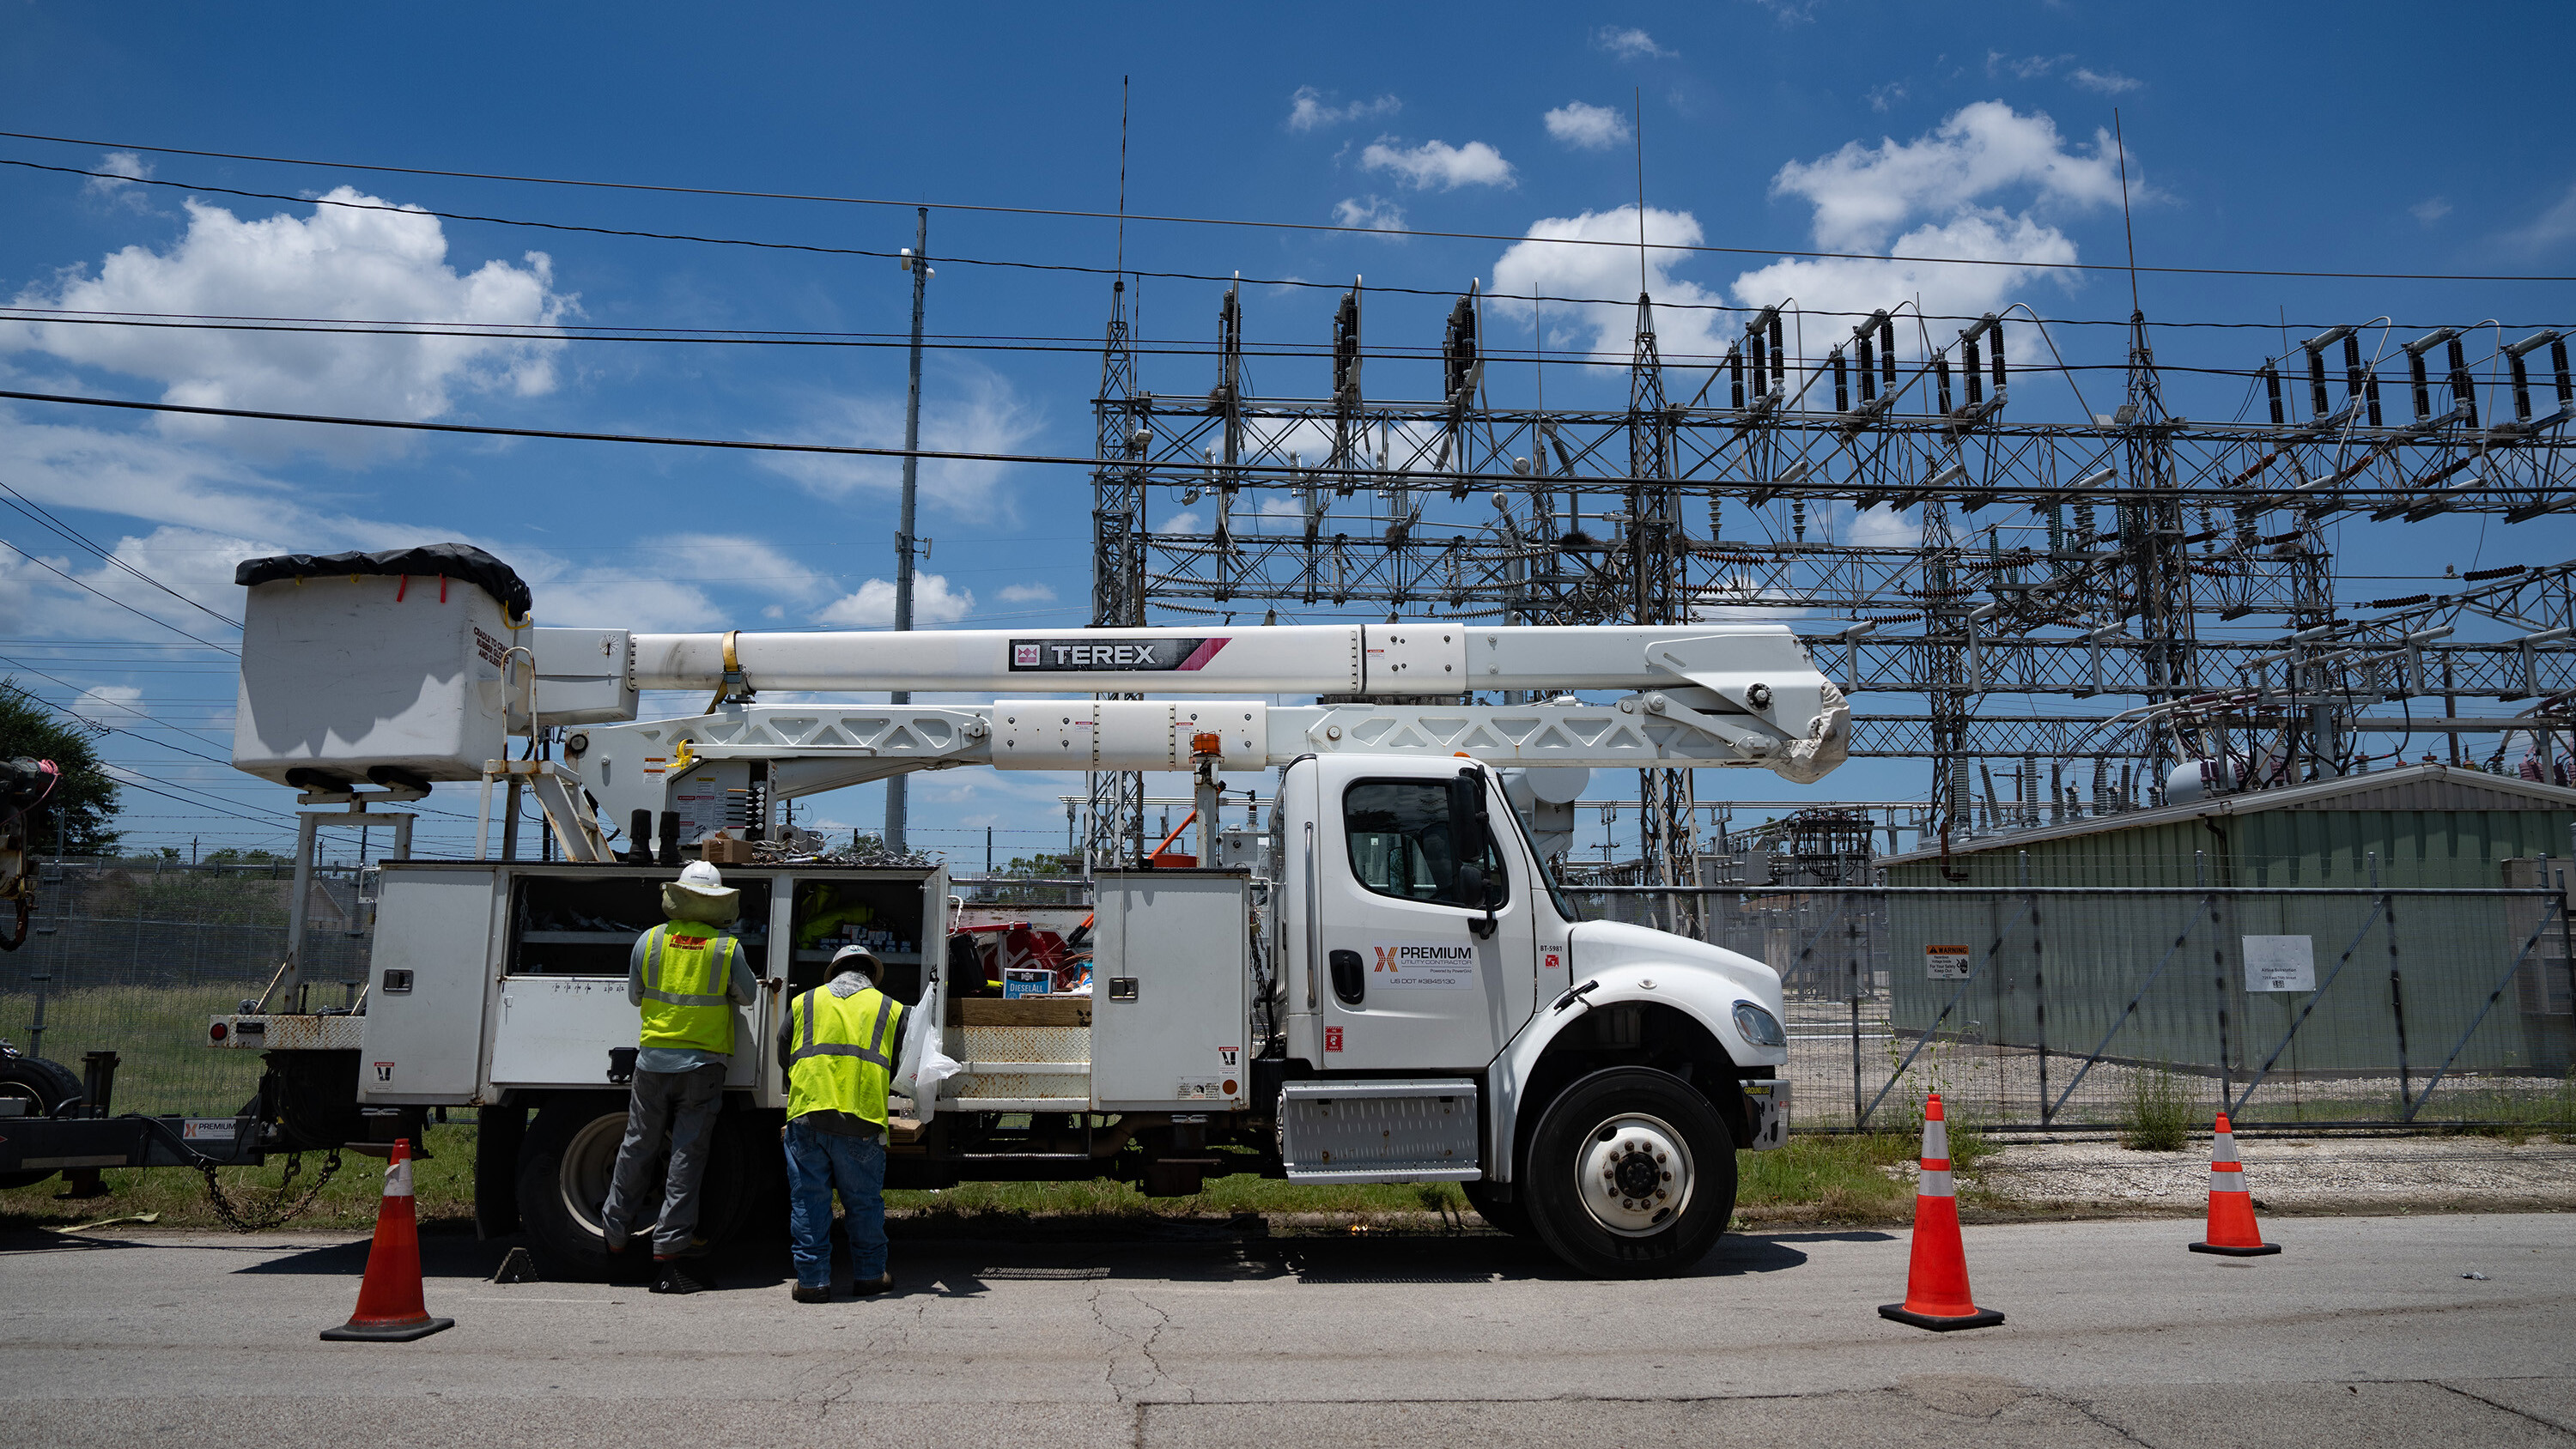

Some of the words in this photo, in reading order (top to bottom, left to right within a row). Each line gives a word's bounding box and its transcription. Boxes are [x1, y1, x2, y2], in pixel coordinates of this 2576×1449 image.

[473, 627, 490, 644] CRADLE
[491, 638, 497, 646] TO
[477, 638, 493, 654] RUBBER
[478, 649, 489, 660] AND
[1051, 645, 1156, 665] TEREX
[1400, 947, 1472, 959] PREMIUM
[1744, 1086, 1761, 1094] GROUND
